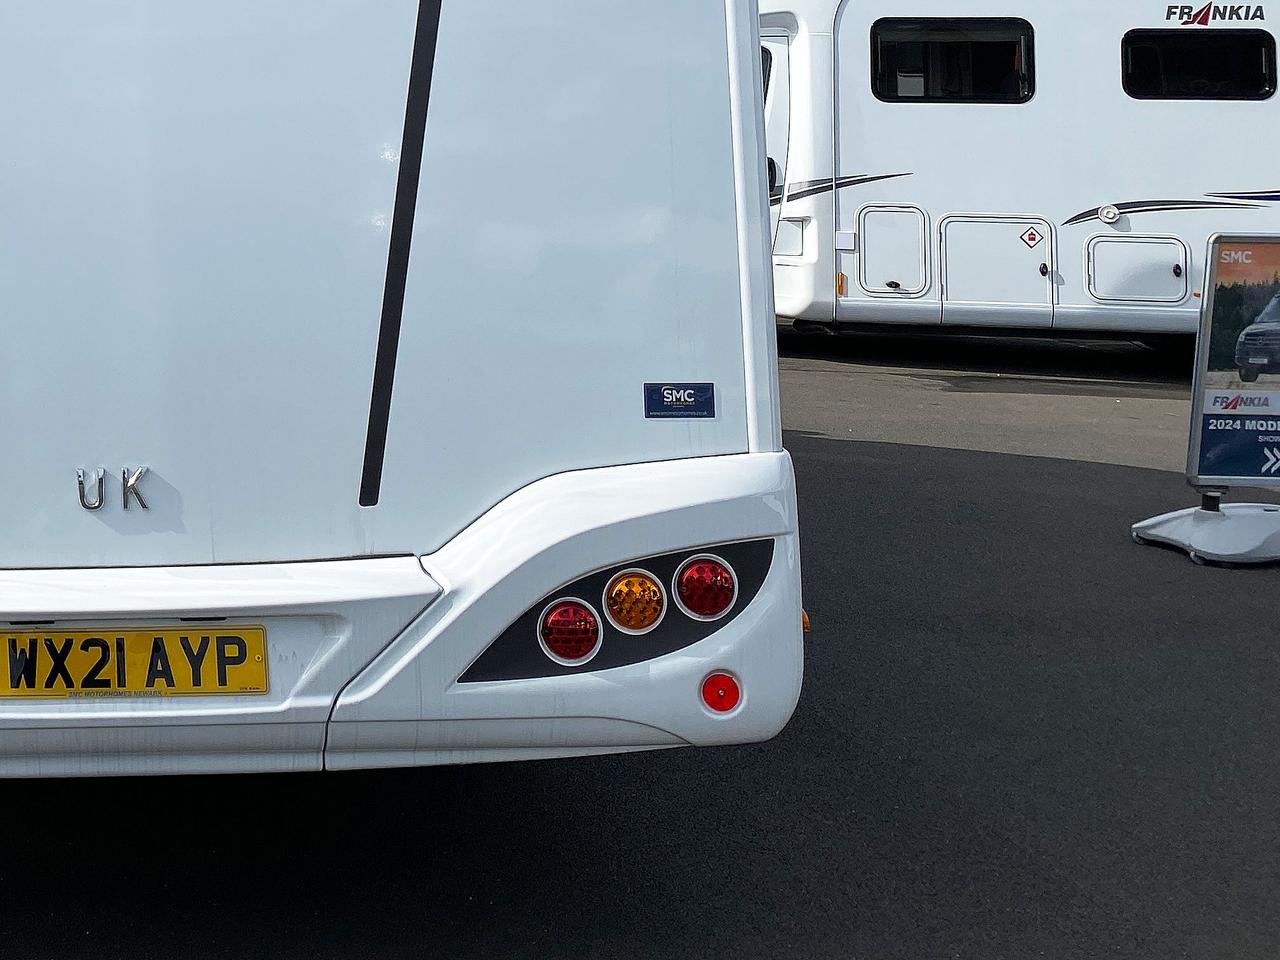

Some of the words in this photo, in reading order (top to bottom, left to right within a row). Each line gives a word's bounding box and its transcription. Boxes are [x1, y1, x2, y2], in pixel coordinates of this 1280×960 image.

[1165, 1, 1265, 26] FRANKIA
[1220, 250, 1252, 264] SMC
[663, 389, 695, 402] SMC
[1212, 395, 1269, 410] FRANKIA
[1208, 419, 1241, 430] 2024
[77, 466, 148, 511] UK
[7, 637, 127, 689] WX21
[145, 635, 248, 688] AYP
